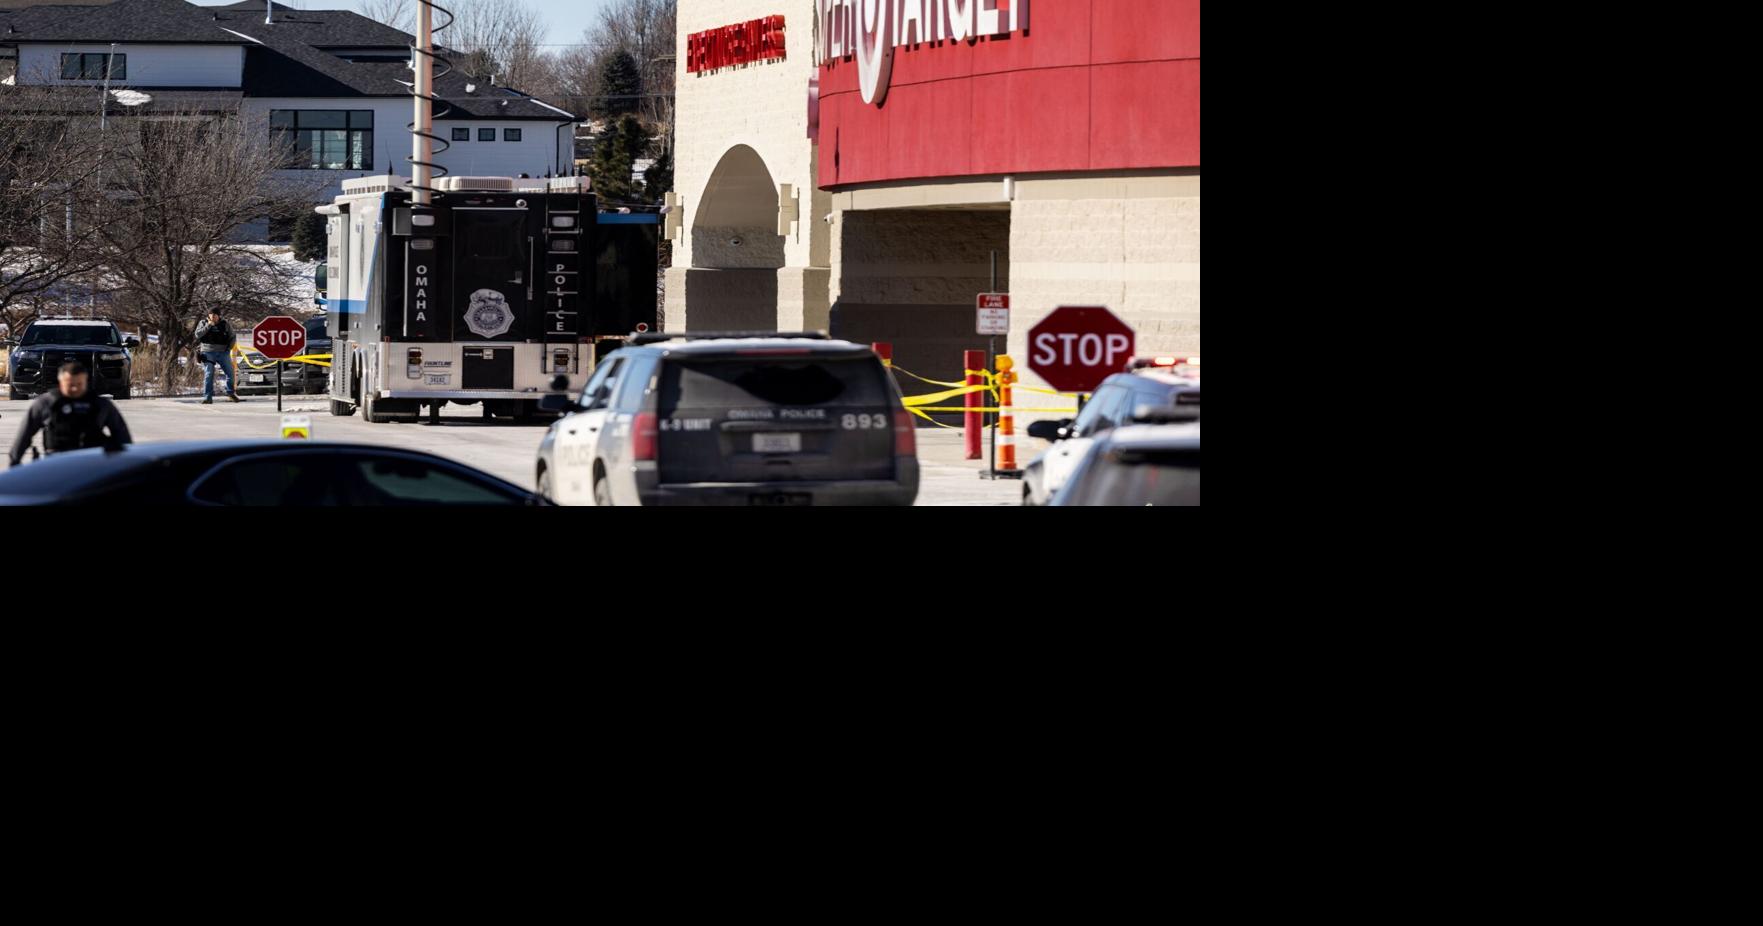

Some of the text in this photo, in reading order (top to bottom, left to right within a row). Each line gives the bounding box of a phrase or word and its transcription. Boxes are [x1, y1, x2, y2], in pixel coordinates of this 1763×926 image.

[415, 265, 428, 322] OMAHA
[554, 263, 567, 332] POLICE
[256, 330, 302, 346] STOP
[1033, 333, 1129, 367] STOP
[780, 408, 827, 420] POLICE
[841, 413, 888, 430] 893
